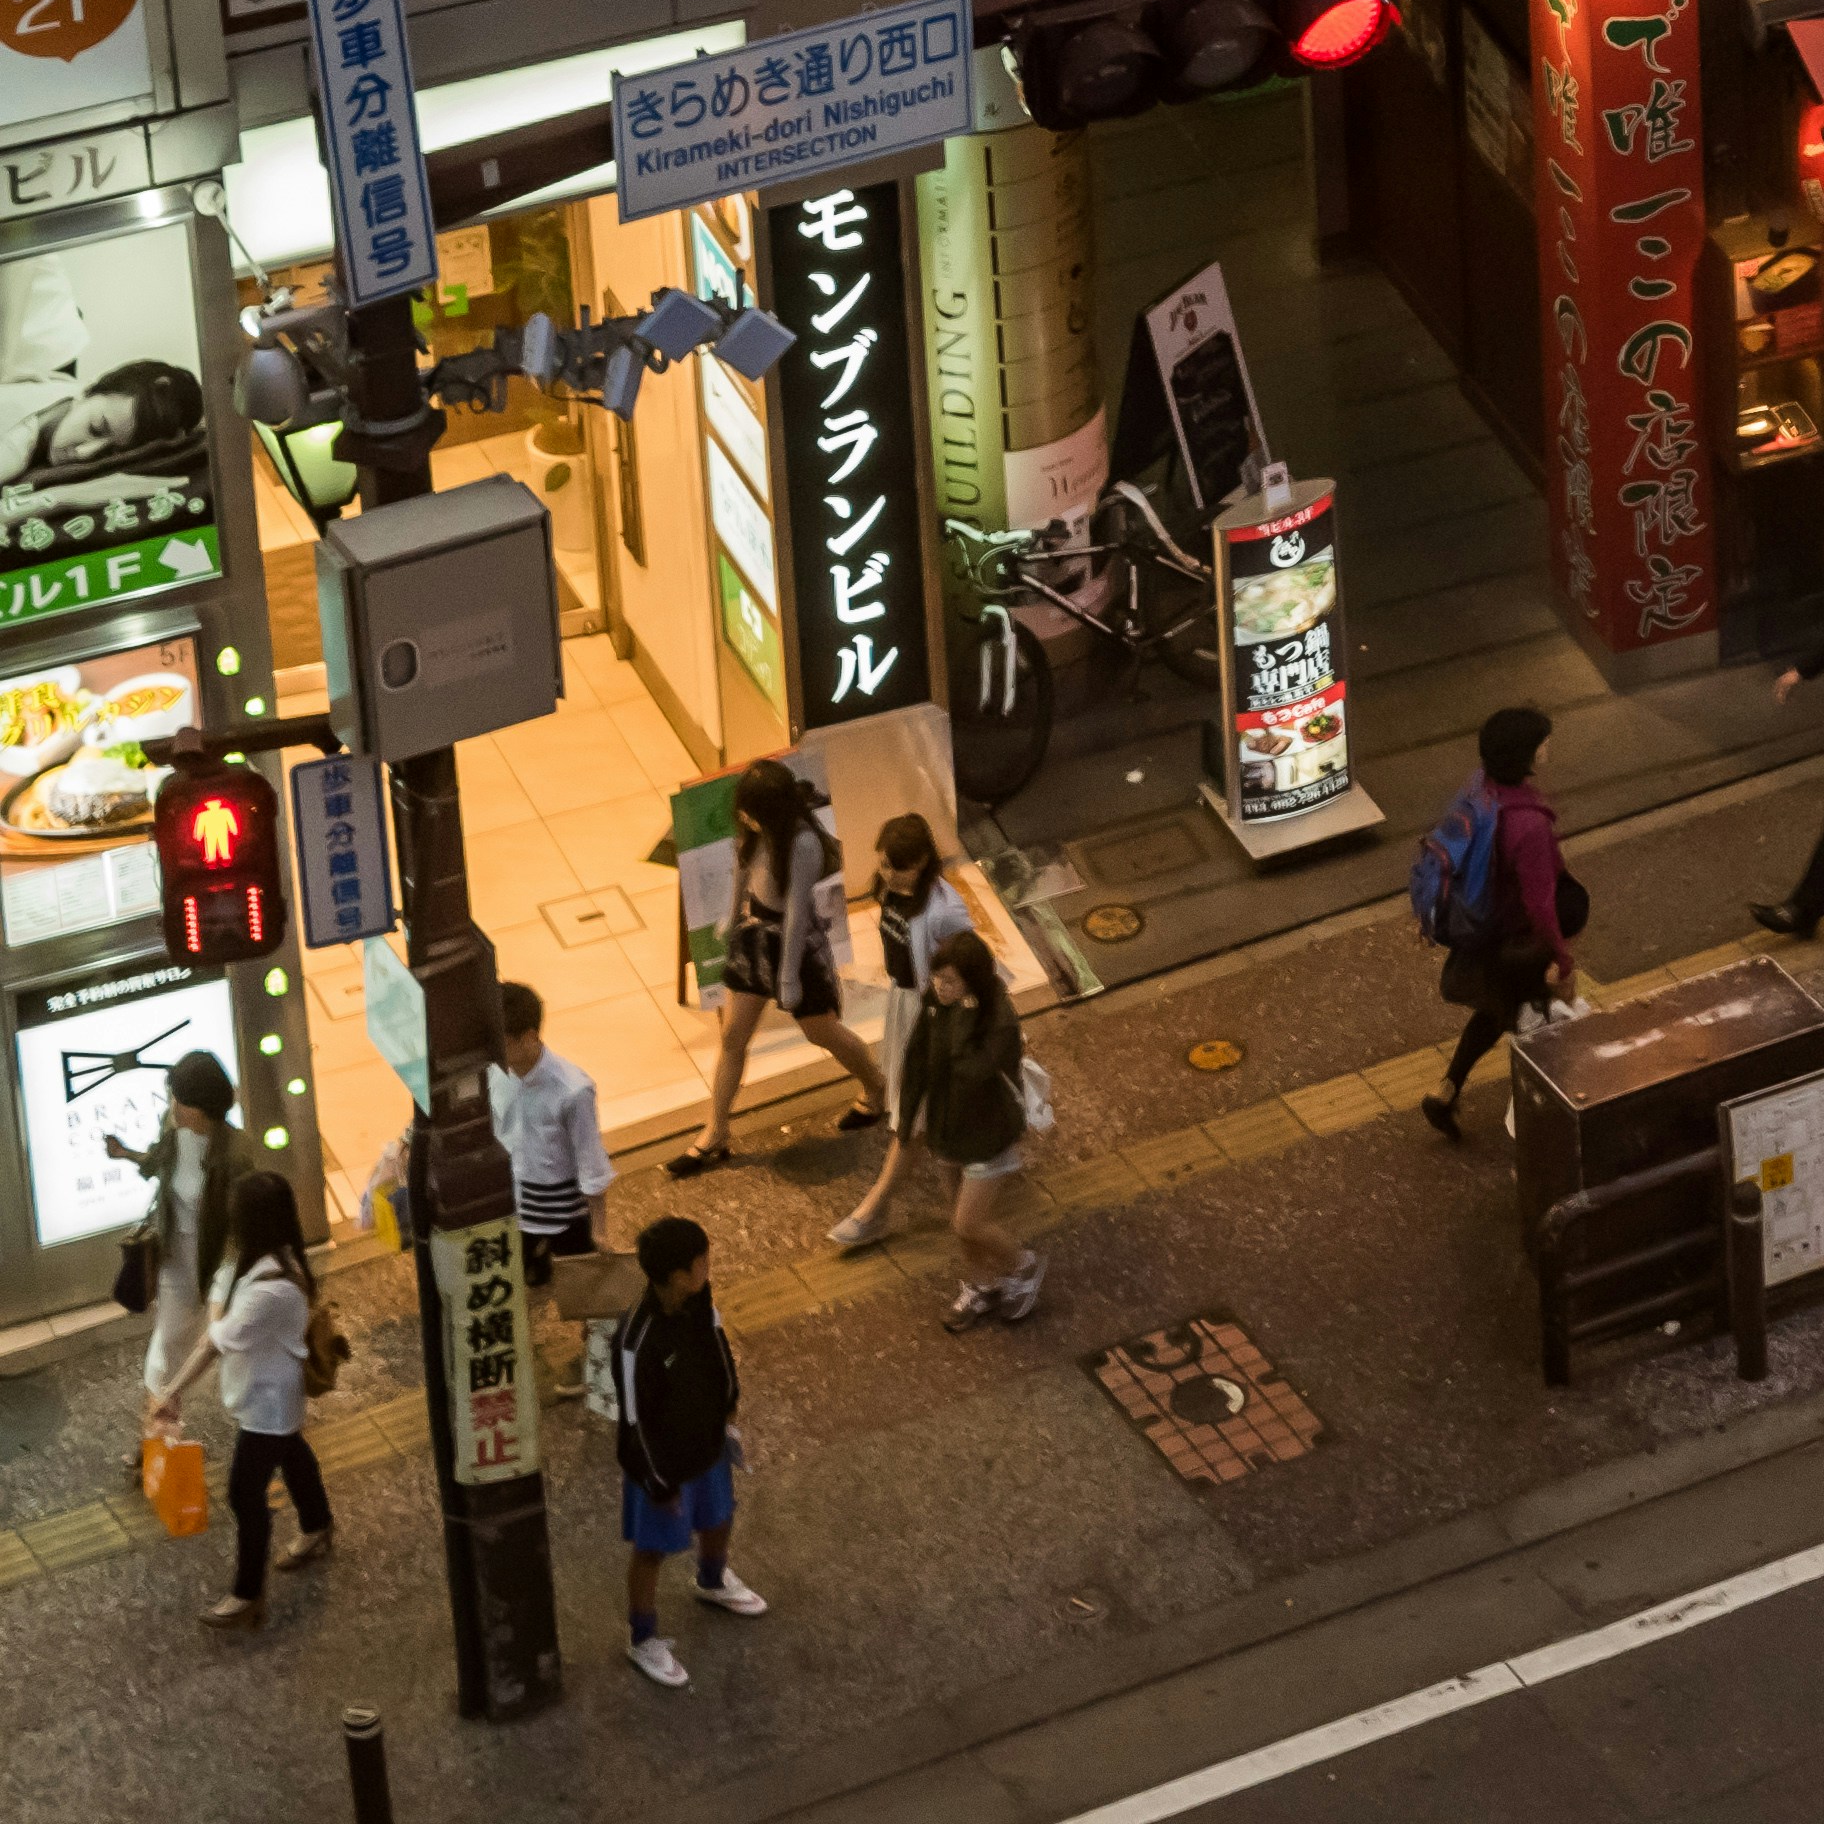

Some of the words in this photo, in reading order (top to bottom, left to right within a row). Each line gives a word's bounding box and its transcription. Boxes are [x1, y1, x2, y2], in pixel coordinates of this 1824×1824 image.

[627, 12, 958, 139] きらめき通り西口
[635, 110, 813, 176] Kirameki-dori
[824, 72, 955, 127] Nishiguchi
[717, 125, 877, 181] INTERSECTION
[799, 188, 900, 705] モンブランビル
[1251, 623, 1330, 668] もつ鍋
[465, 1232, 520, 1470] 斜め横断禁止
